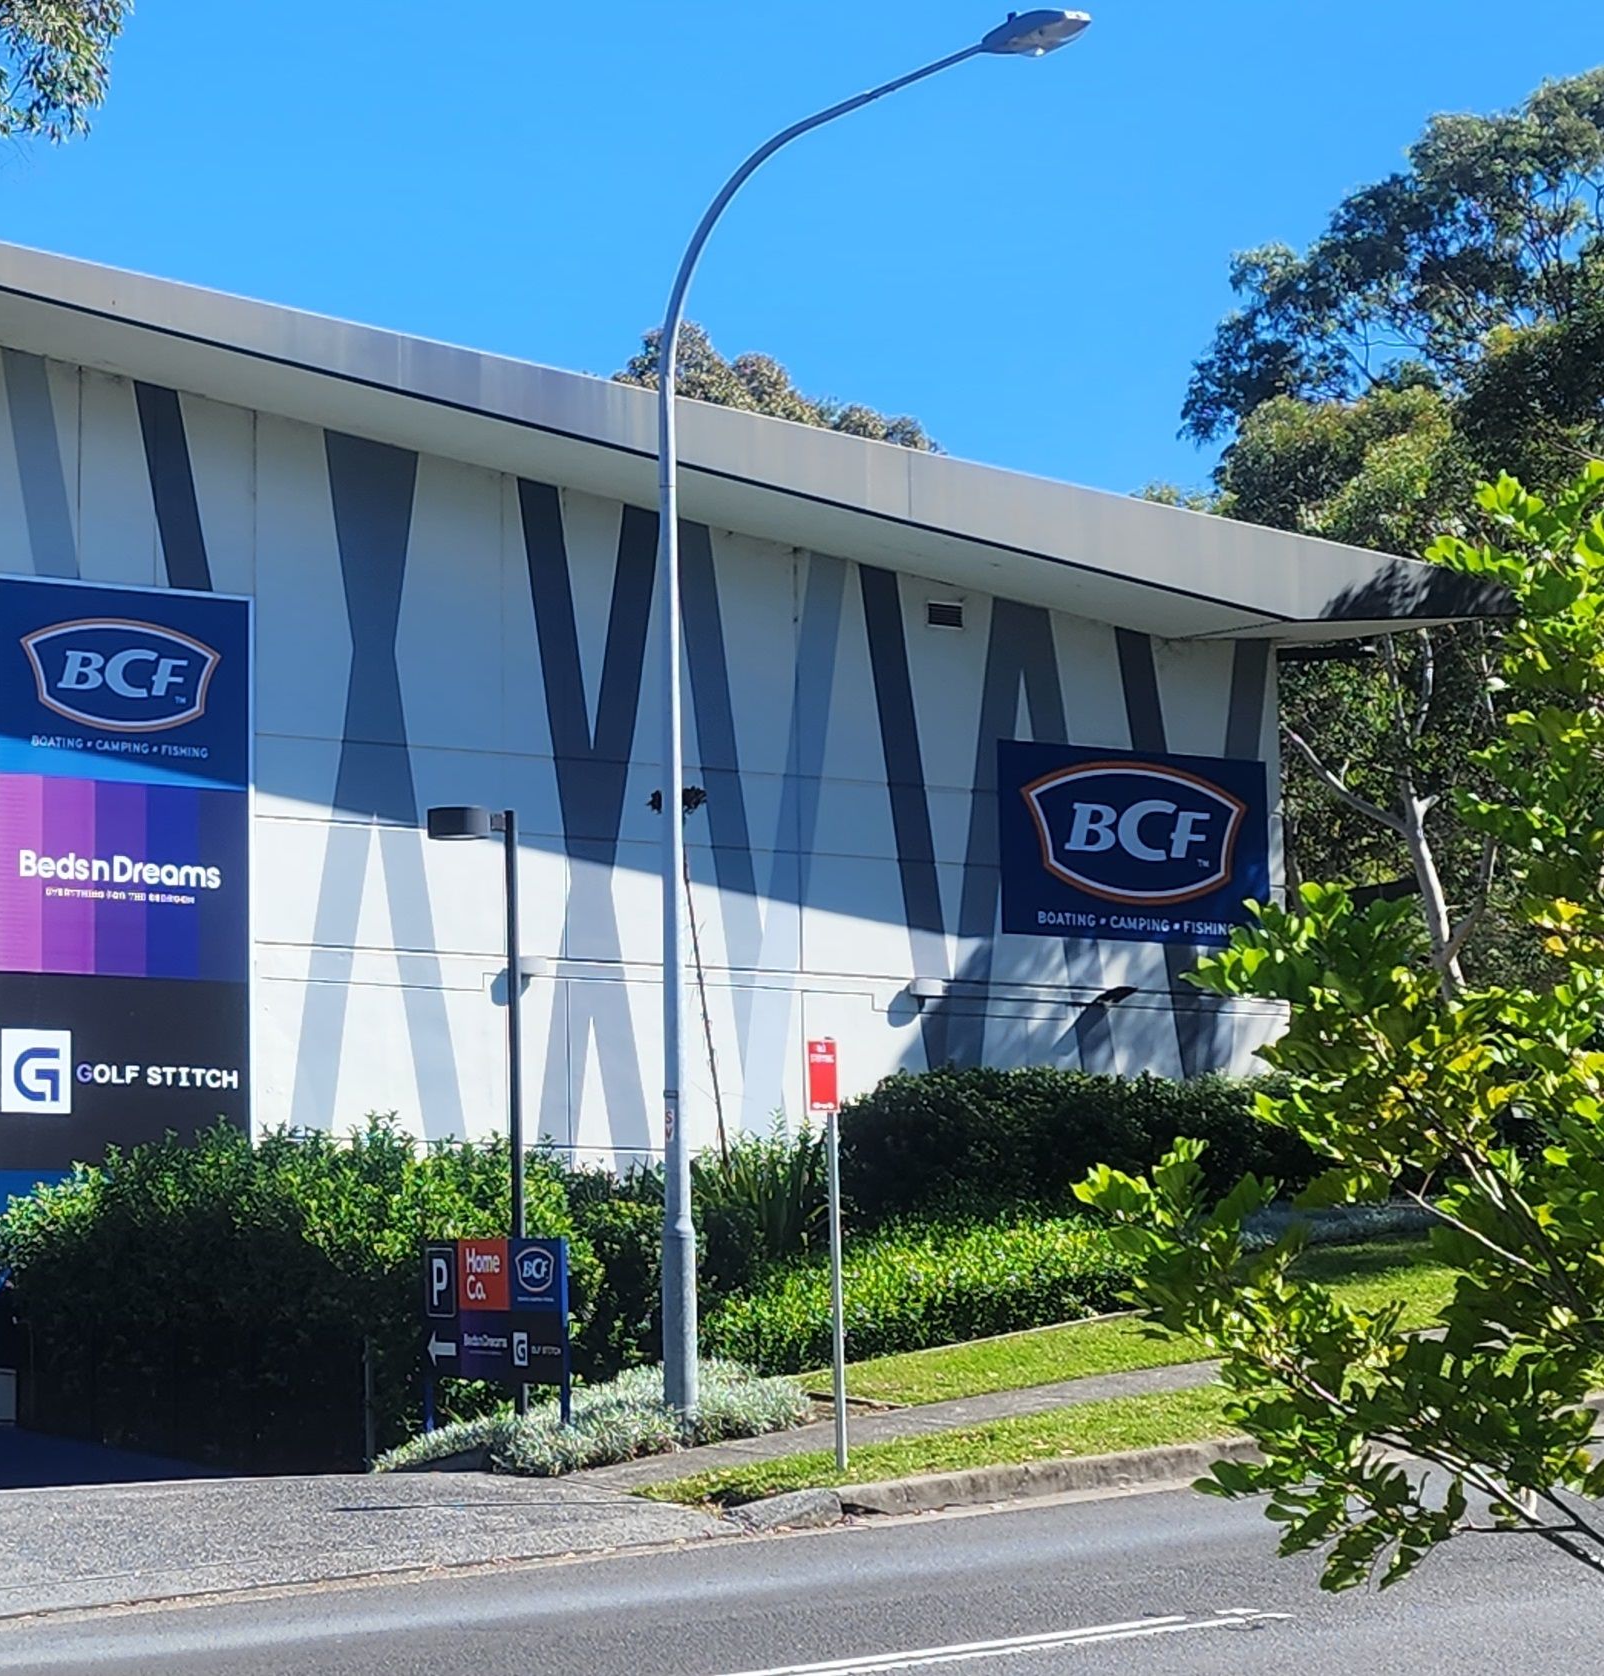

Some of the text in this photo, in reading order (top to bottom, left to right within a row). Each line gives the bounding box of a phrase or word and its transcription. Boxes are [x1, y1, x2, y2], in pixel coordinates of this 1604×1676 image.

[56, 648, 188, 698] BCF
[30, 735, 209, 758] BOATING CAMPING FISHING
[1064, 799, 1211, 862] BCF
[1037, 910, 1097, 927] BOATING
[1109, 915, 1171, 932] CAMPING
[76, 1063, 239, 1089] GOLF STITCH
[465, 1247, 500, 1273] Home
[522, 1258, 549, 1279] BCF
[432, 1258, 448, 1306] P
